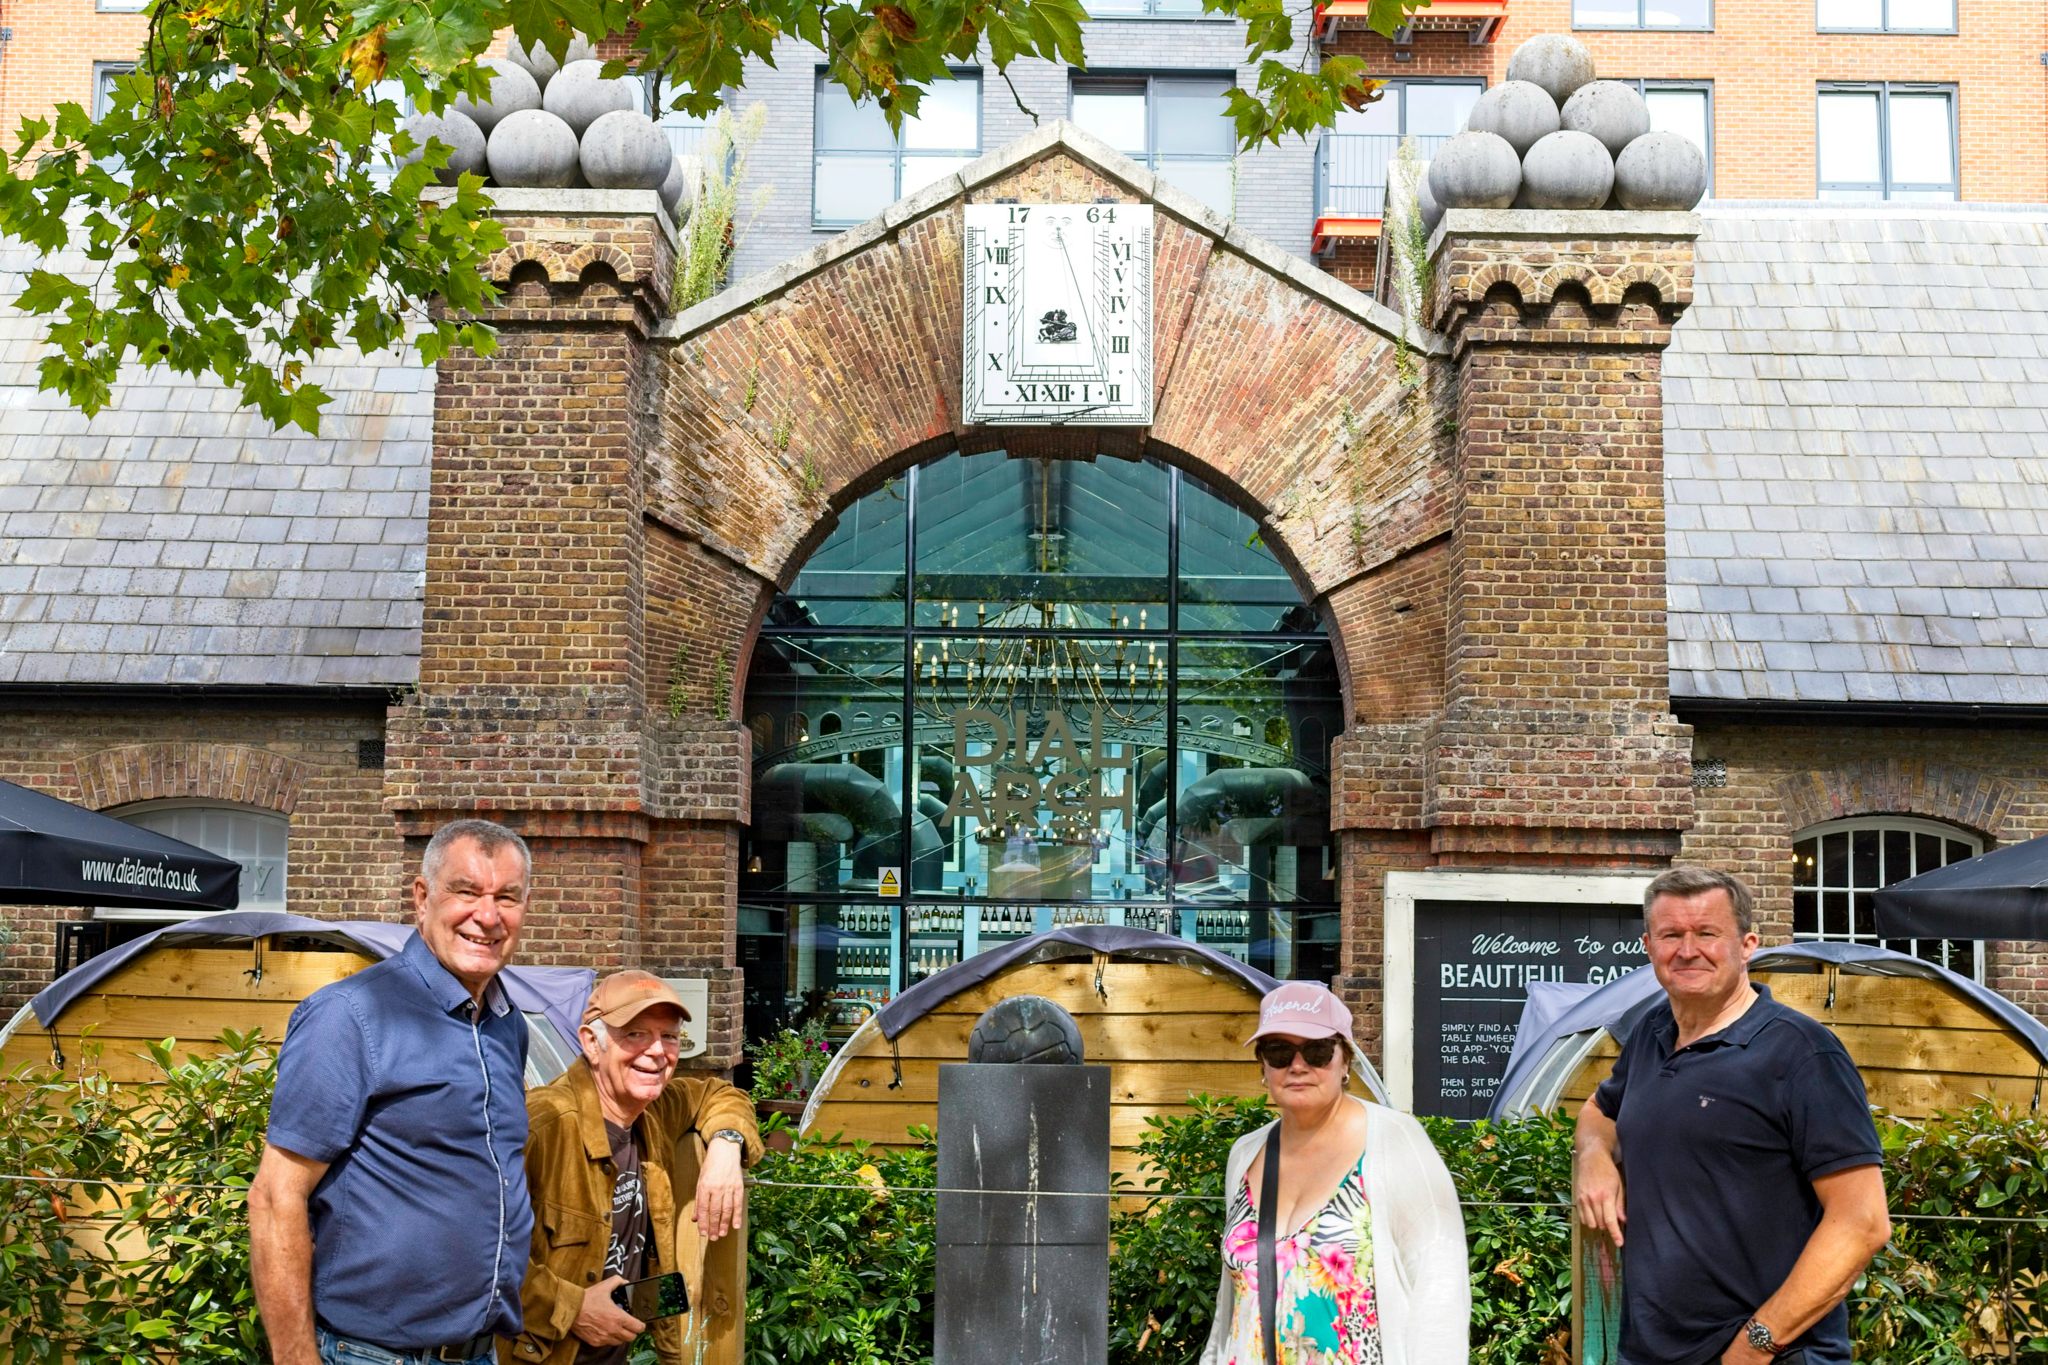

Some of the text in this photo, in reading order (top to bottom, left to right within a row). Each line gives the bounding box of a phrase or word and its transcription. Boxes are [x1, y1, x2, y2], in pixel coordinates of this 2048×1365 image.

[1008, 207, 1117, 223] 17 64
[985, 247, 1010, 264] VIII
[1111, 243, 1131, 260] VI
[1114, 267, 1128, 284] V
[985, 286, 1008, 304] IX
[1110, 296, 1131, 313] IV
[1111, 336, 1130, 353] III
[987, 352, 1004, 370] X
[1016, 384, 1121, 402] XI XII I II
[850, 731, 902, 751] DICKSO
[954, 709, 1133, 768] DIAL
[939, 772, 1133, 830] ARCH
[82, 857, 201, 893] www.dialarch.co.uk
[1471, 933, 1561, 956] Welcome
[1573, 935, 1605, 955] to
[1262, 994, 1324, 1025] Arsenal
[1441, 1023, 1475, 1032] SIMPLY
[1479, 1023, 1501, 1032] FIND
[1503, 1024, 1511, 1032] A
[1441, 1034, 1516, 1043] TABLE NUMBER
[1440, 1045, 1460, 1053] OUR
[1441, 1055, 1458, 1064] THE
[1440, 1078, 1464, 1087] THEN
[1471, 1078, 1485, 1087] SIT
[1440, 1088, 1494, 1098] FOOD AND
